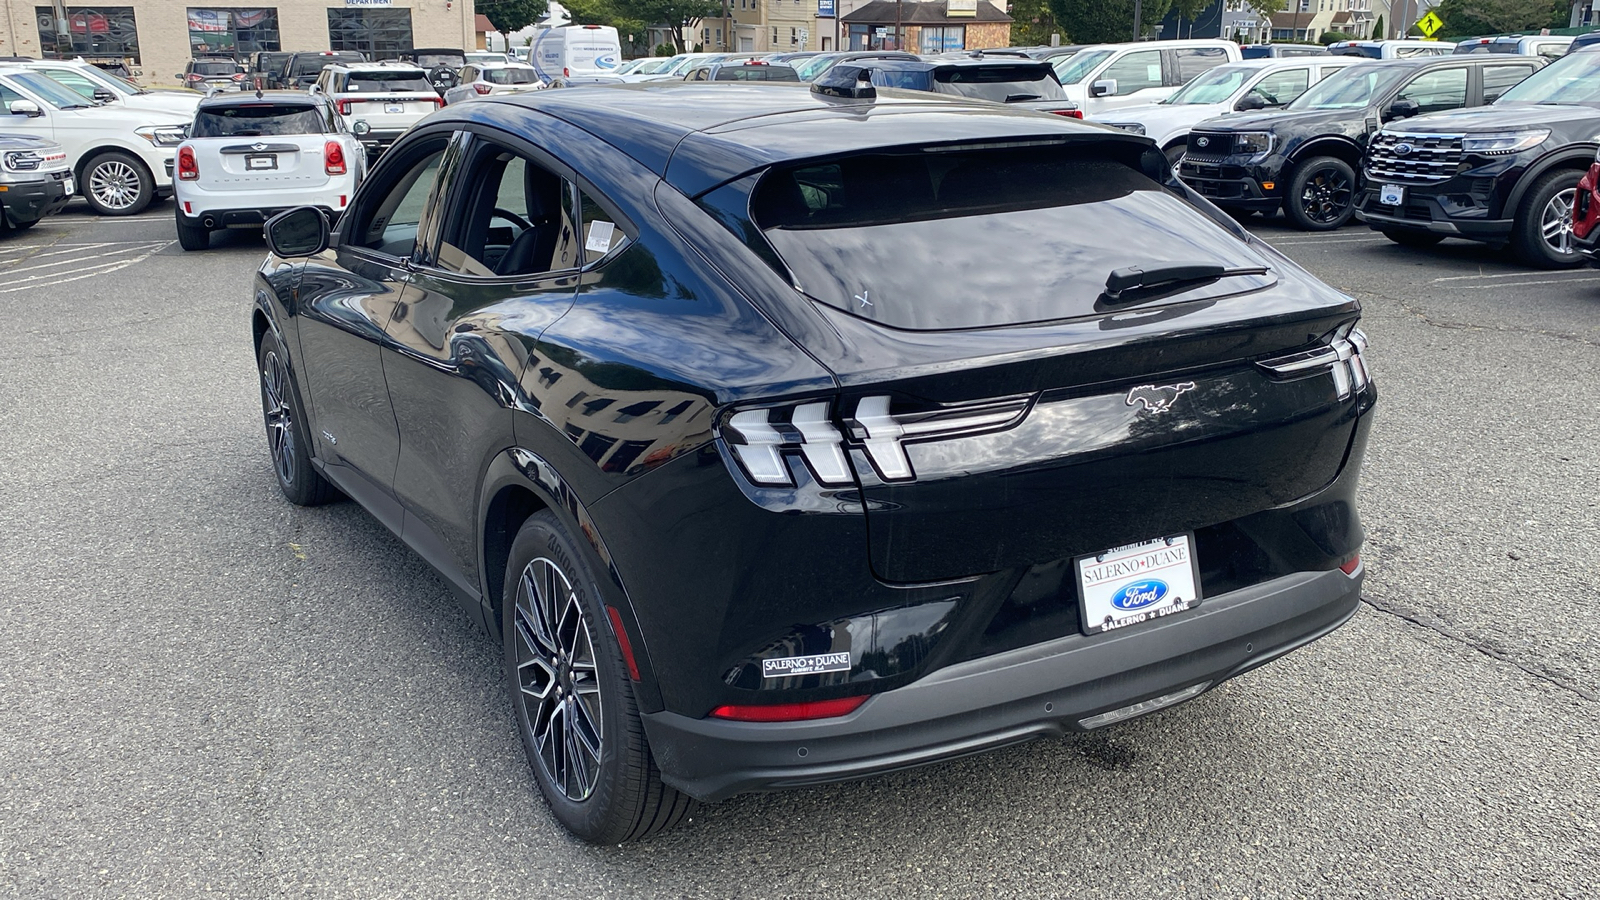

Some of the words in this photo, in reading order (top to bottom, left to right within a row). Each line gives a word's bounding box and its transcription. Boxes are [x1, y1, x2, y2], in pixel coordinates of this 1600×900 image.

[1084, 559, 1140, 583] SALERNO
[1145, 547, 1187, 568] DUANE
[1122, 583, 1158, 608] Ford
[1101, 613, 1146, 632] SALERNO
[1159, 601, 1190, 616] DUANE
[765, 658, 807, 671] SALERNO
[815, 654, 848, 666] DUANE
